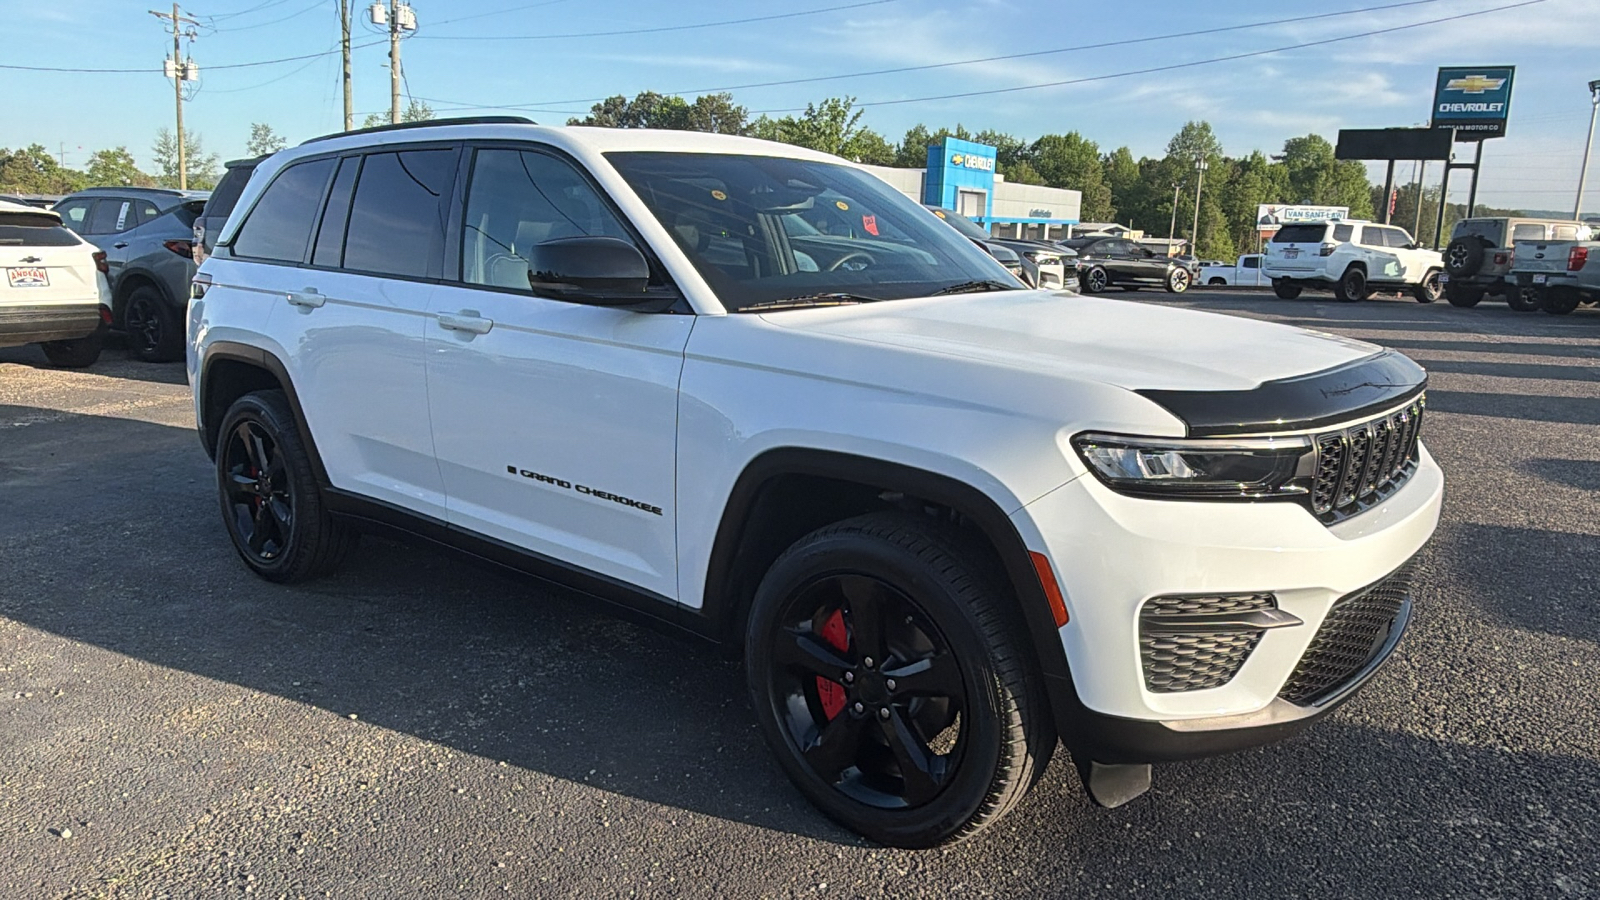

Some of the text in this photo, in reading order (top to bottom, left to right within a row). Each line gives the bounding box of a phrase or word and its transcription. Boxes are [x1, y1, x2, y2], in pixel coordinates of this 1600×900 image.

[1439, 103, 1504, 112] CHEVROLET
[964, 154, 993, 171] CHEVROLET
[520, 469, 663, 516] GRAND CHEROKEE
